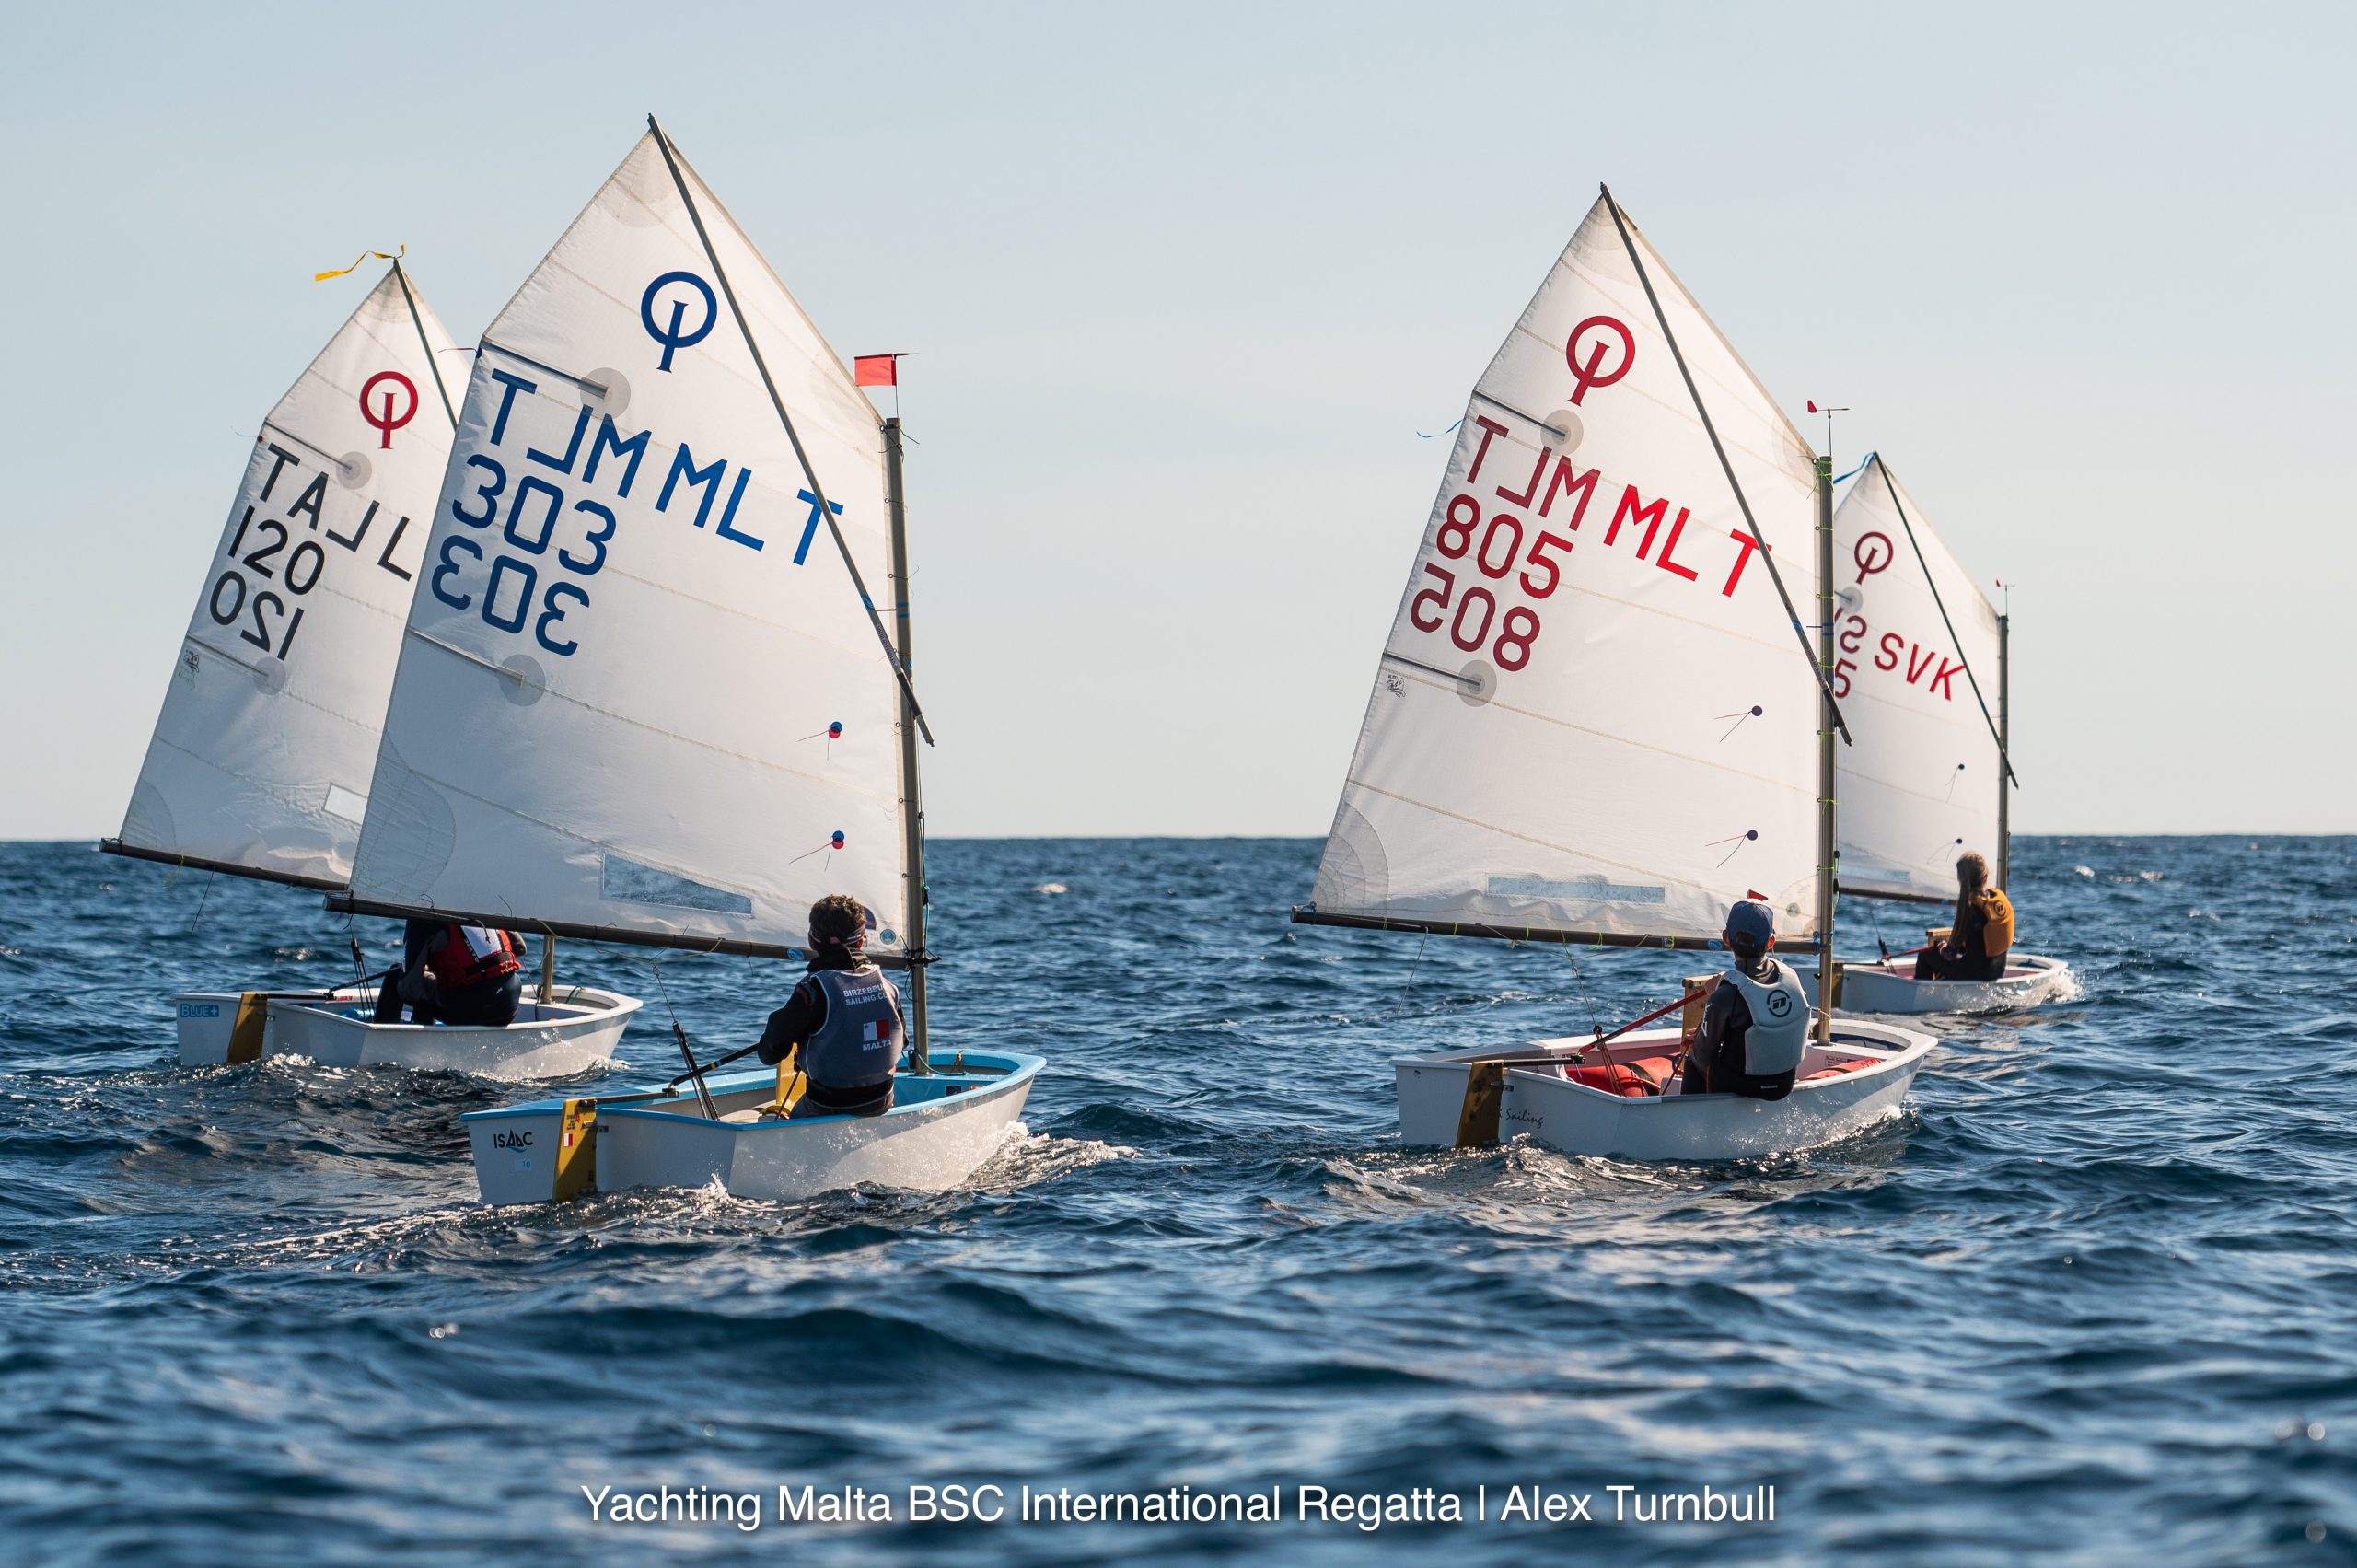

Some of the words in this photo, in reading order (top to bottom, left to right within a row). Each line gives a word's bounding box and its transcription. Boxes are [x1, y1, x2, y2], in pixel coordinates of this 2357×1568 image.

[452, 454, 617, 576] 303
[655, 443, 844, 566] MLT
[1436, 494, 1574, 600] 805
[1603, 483, 1772, 598] MLT
[226, 505, 326, 597] 120
[1874, 633, 1967, 702] SVK
[845, 994, 877, 1006] SAILING
[863, 1039, 892, 1051] MALTA
[1505, 1107, 1544, 1130] Sailing
